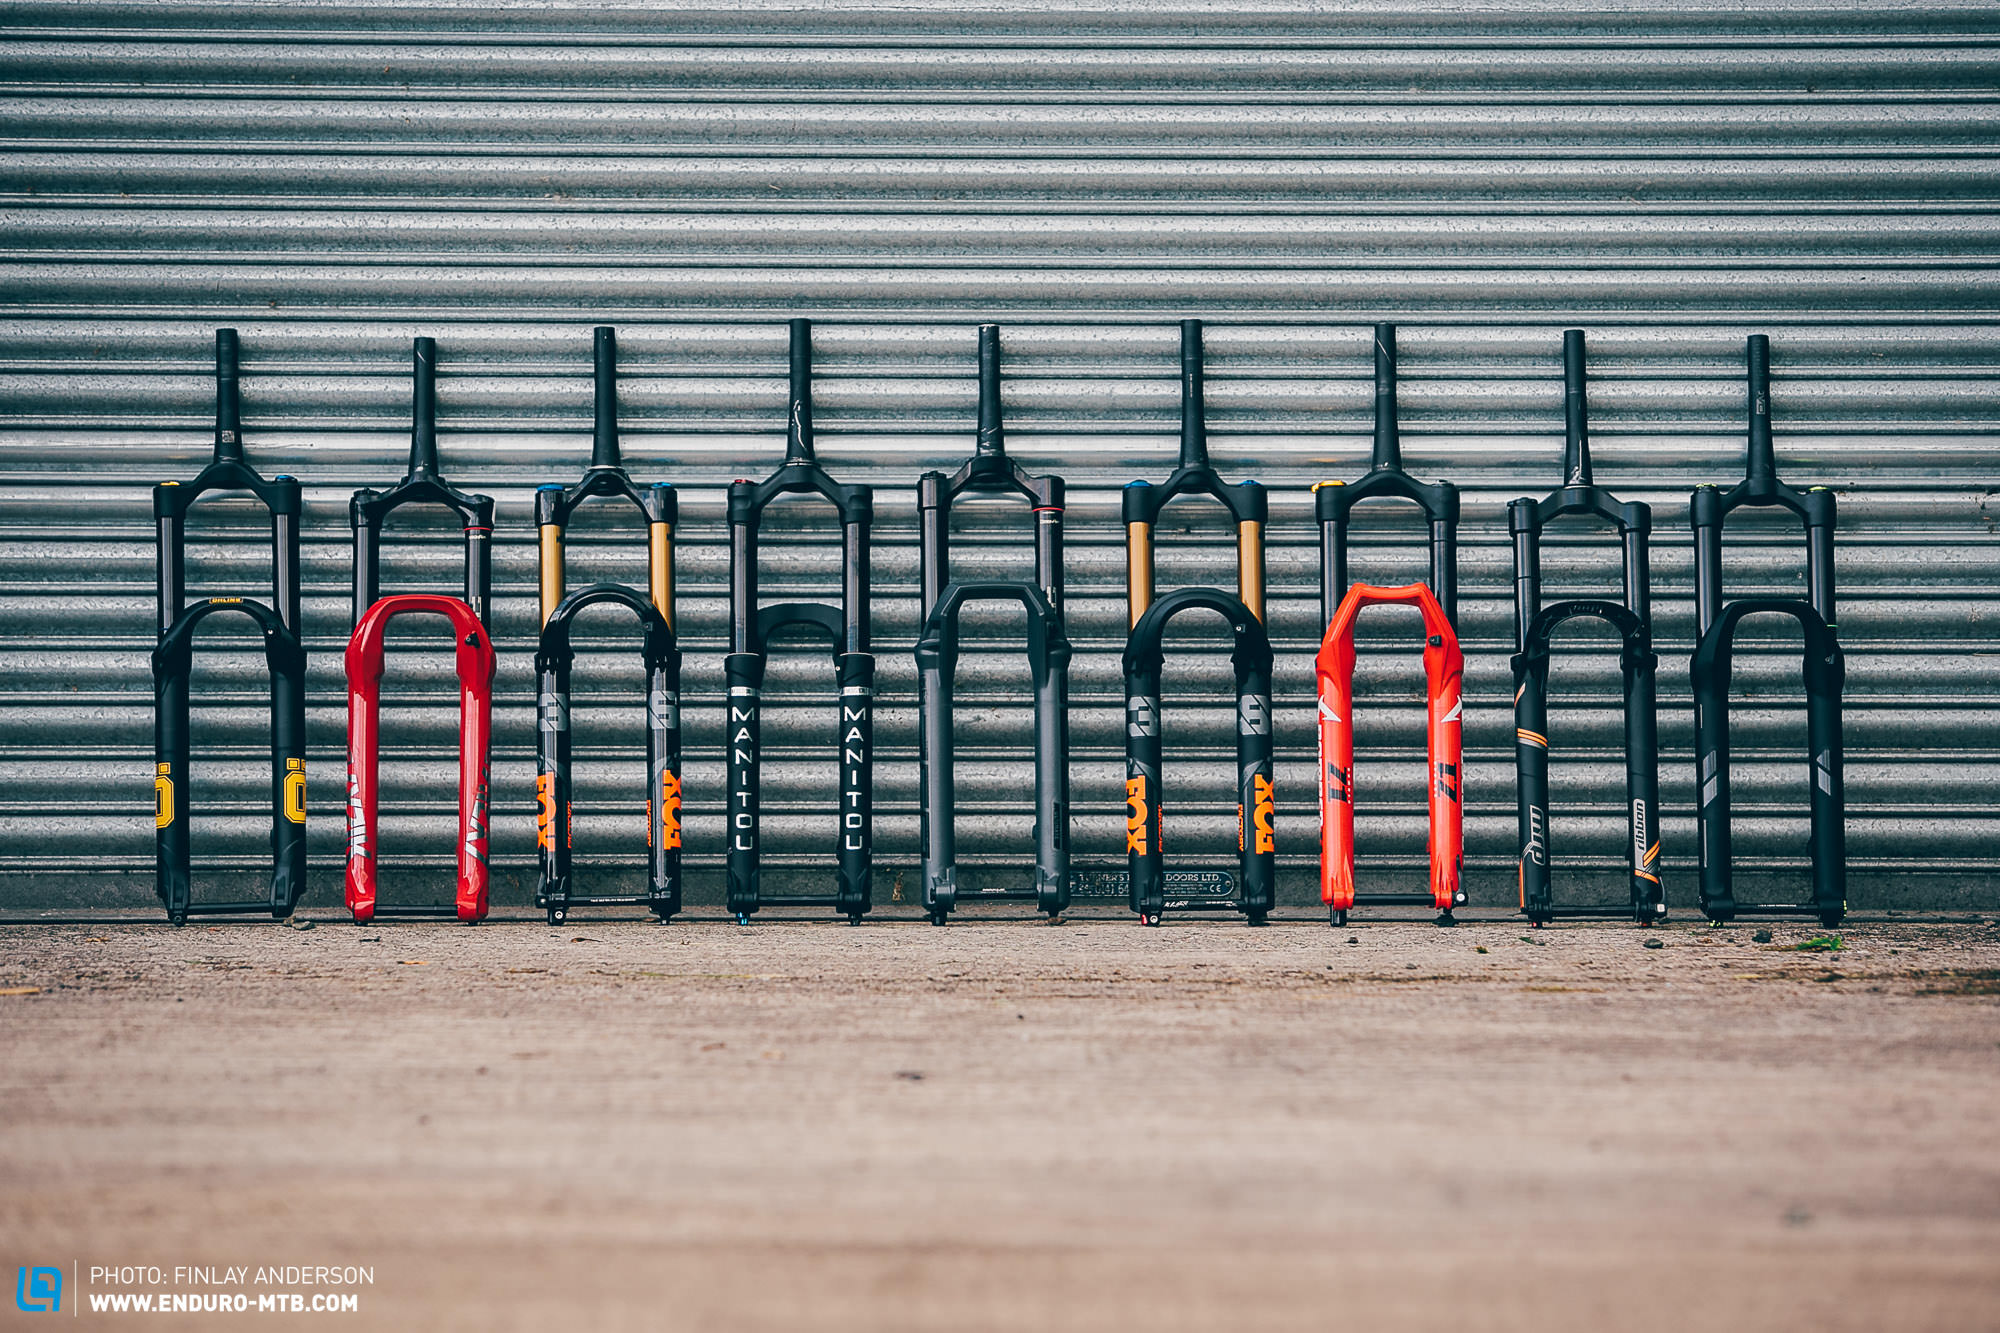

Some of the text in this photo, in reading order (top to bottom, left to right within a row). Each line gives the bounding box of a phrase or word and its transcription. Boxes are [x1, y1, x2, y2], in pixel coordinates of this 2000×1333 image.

[536, 771, 556, 852] FOX
[661, 769, 682, 850] FOX
[732, 706, 754, 850] MANITOU
[844, 706, 866, 850] MANITOU
[1126, 775, 1148, 856] FOX
[1254, 774, 1275, 855] FOX
[1635, 802, 1645, 851] ribbon
[1165, 873, 1222, 882] DOORS LTD.
